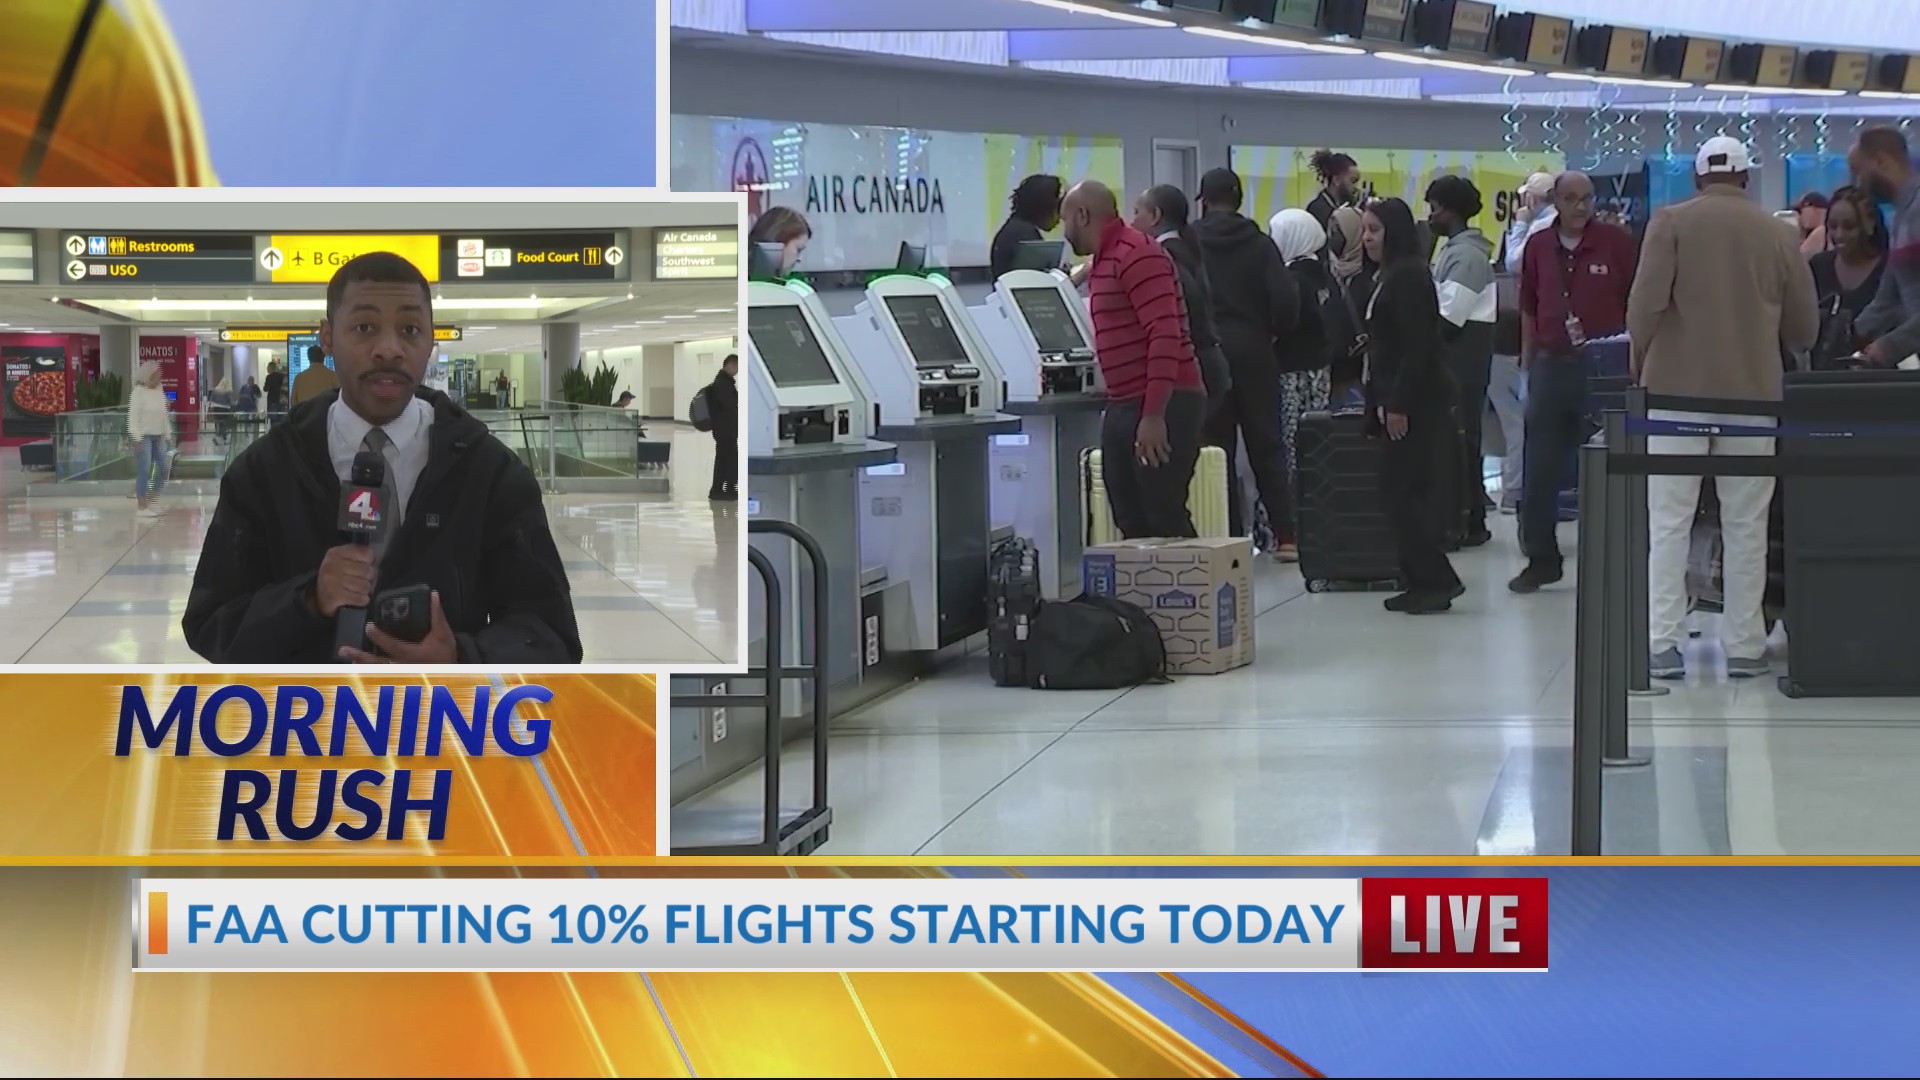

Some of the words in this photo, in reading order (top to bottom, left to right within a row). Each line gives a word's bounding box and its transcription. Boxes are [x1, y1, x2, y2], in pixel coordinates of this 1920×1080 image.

[806, 175, 847, 213] AIR
[852, 175, 944, 213] CANADA
[662, 233, 678, 243] Air
[680, 232, 717, 242] Canada
[129, 240, 195, 253] Restrooms
[313, 252, 324, 265] B
[517, 252, 545, 263] Food
[548, 251, 580, 263] Court
[662, 256, 715, 266] Southwest
[110, 265, 138, 277] USO
[139, 346, 174, 357] ONATOS
[348, 491, 373, 520] 4
